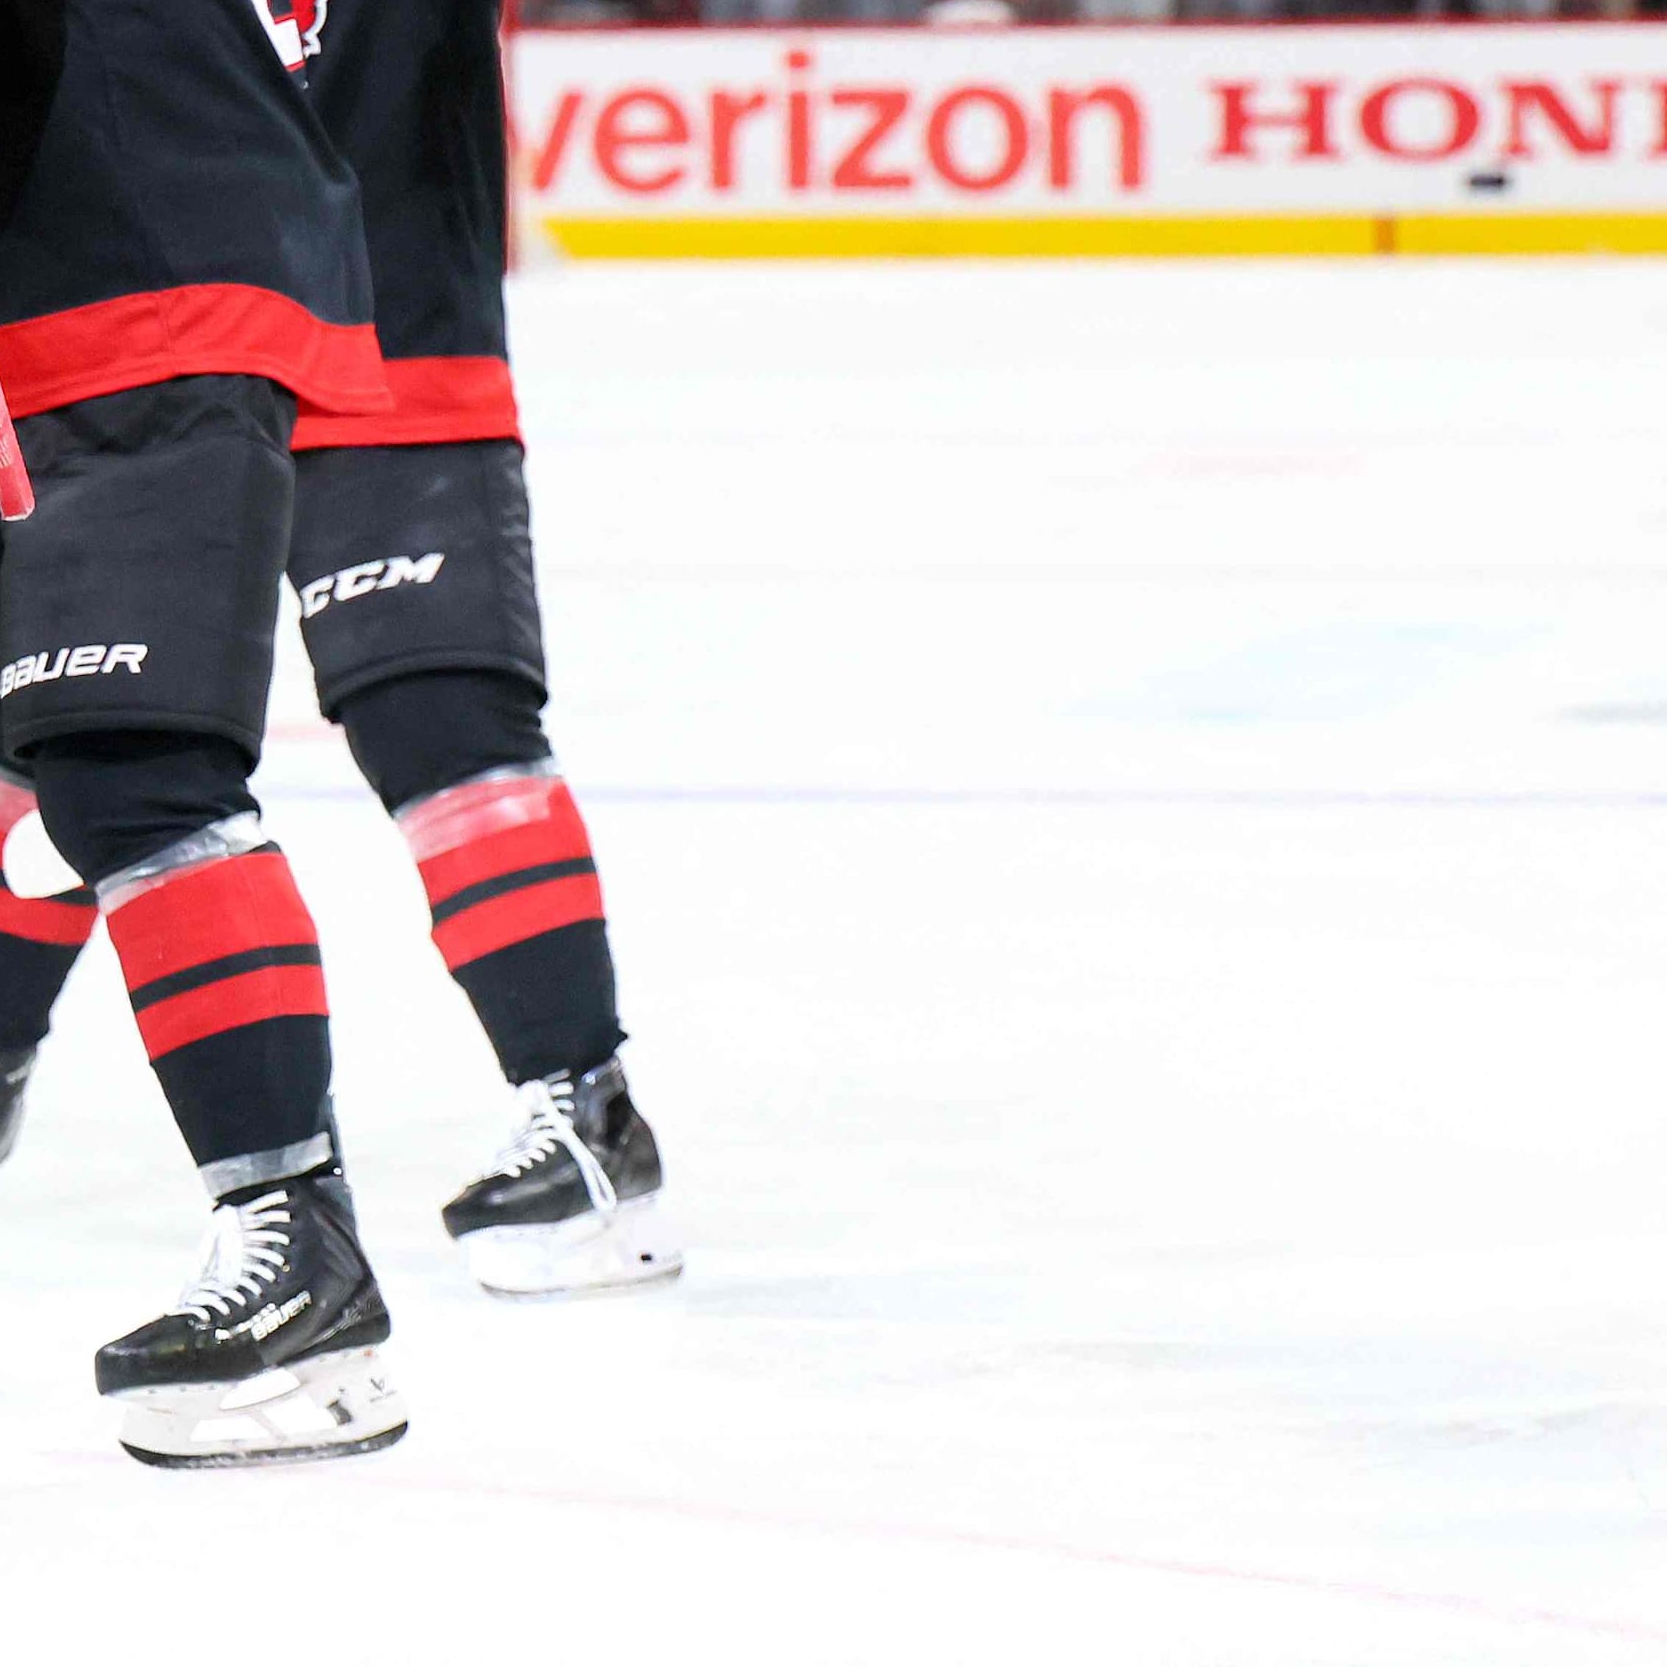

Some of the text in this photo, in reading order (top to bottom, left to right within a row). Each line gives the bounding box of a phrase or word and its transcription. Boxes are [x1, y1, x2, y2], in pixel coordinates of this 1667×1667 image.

[512, 51, 1144, 192] verizon
[1206, 73, 1667, 163] HON
[300, 552, 446, 619] CCM
